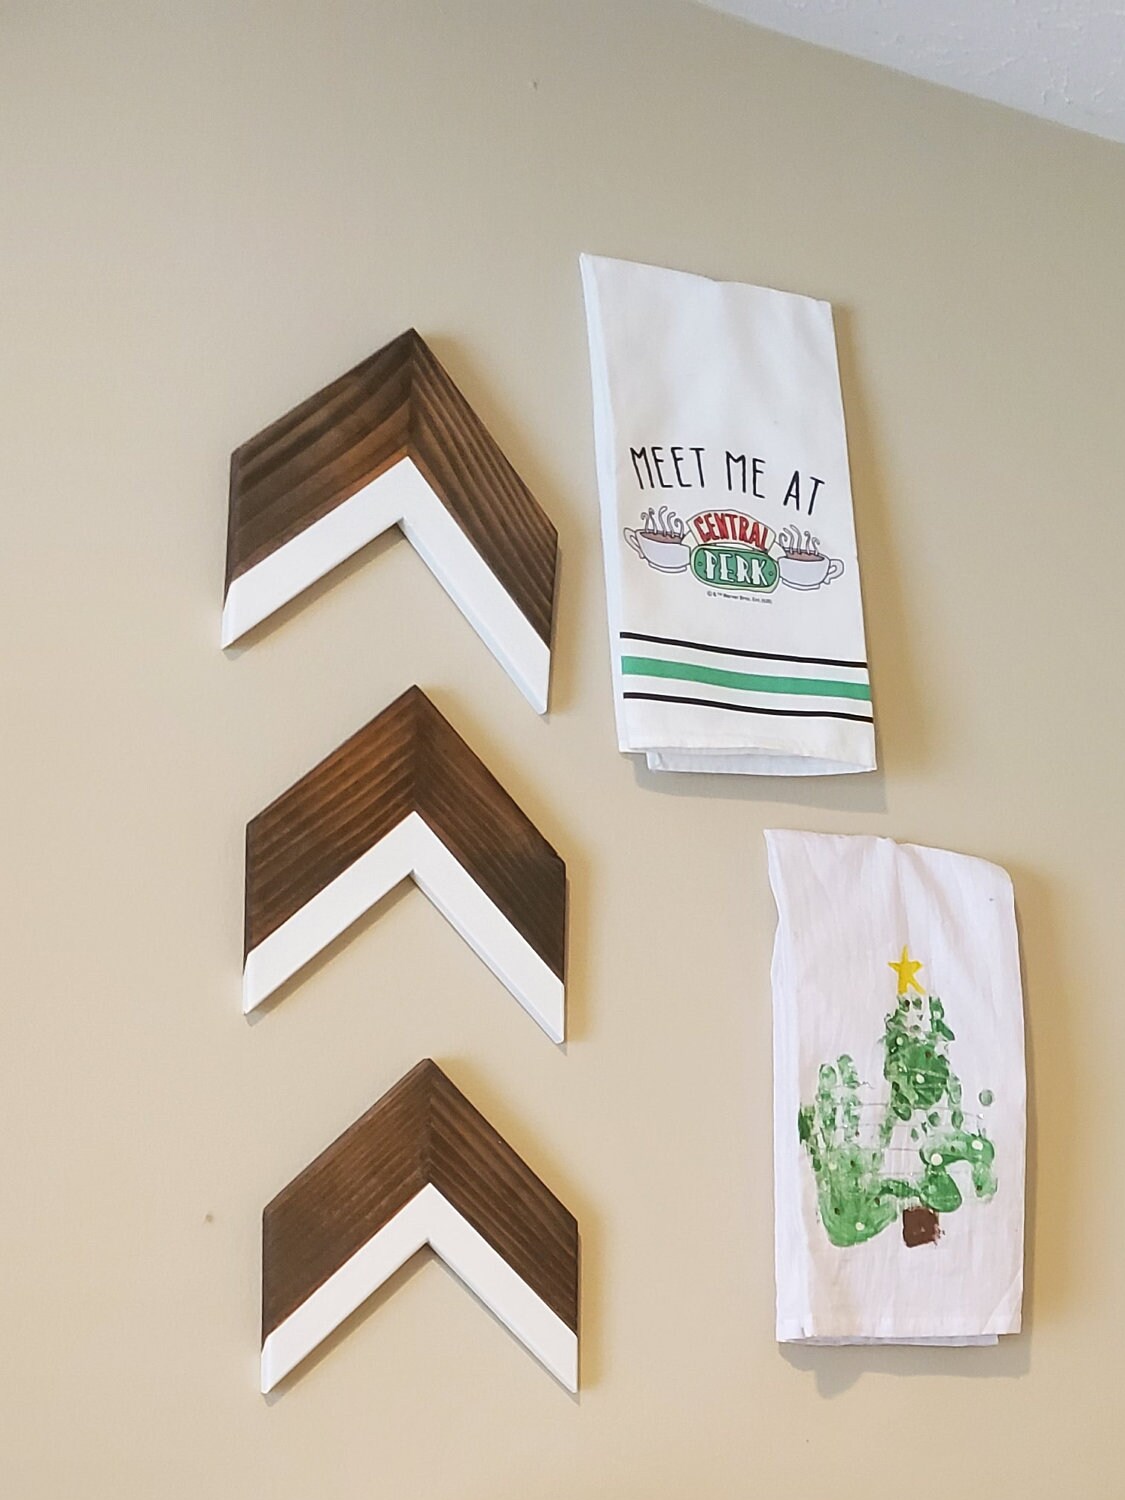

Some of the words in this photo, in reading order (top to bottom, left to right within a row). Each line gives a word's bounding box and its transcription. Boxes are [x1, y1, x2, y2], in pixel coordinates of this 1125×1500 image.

[629, 446, 705, 490] MEET
[725, 451, 766, 499] ME
[783, 470, 825, 516] AT
[693, 512, 770, 551] CENTRAL
[703, 550, 769, 586] PERK
